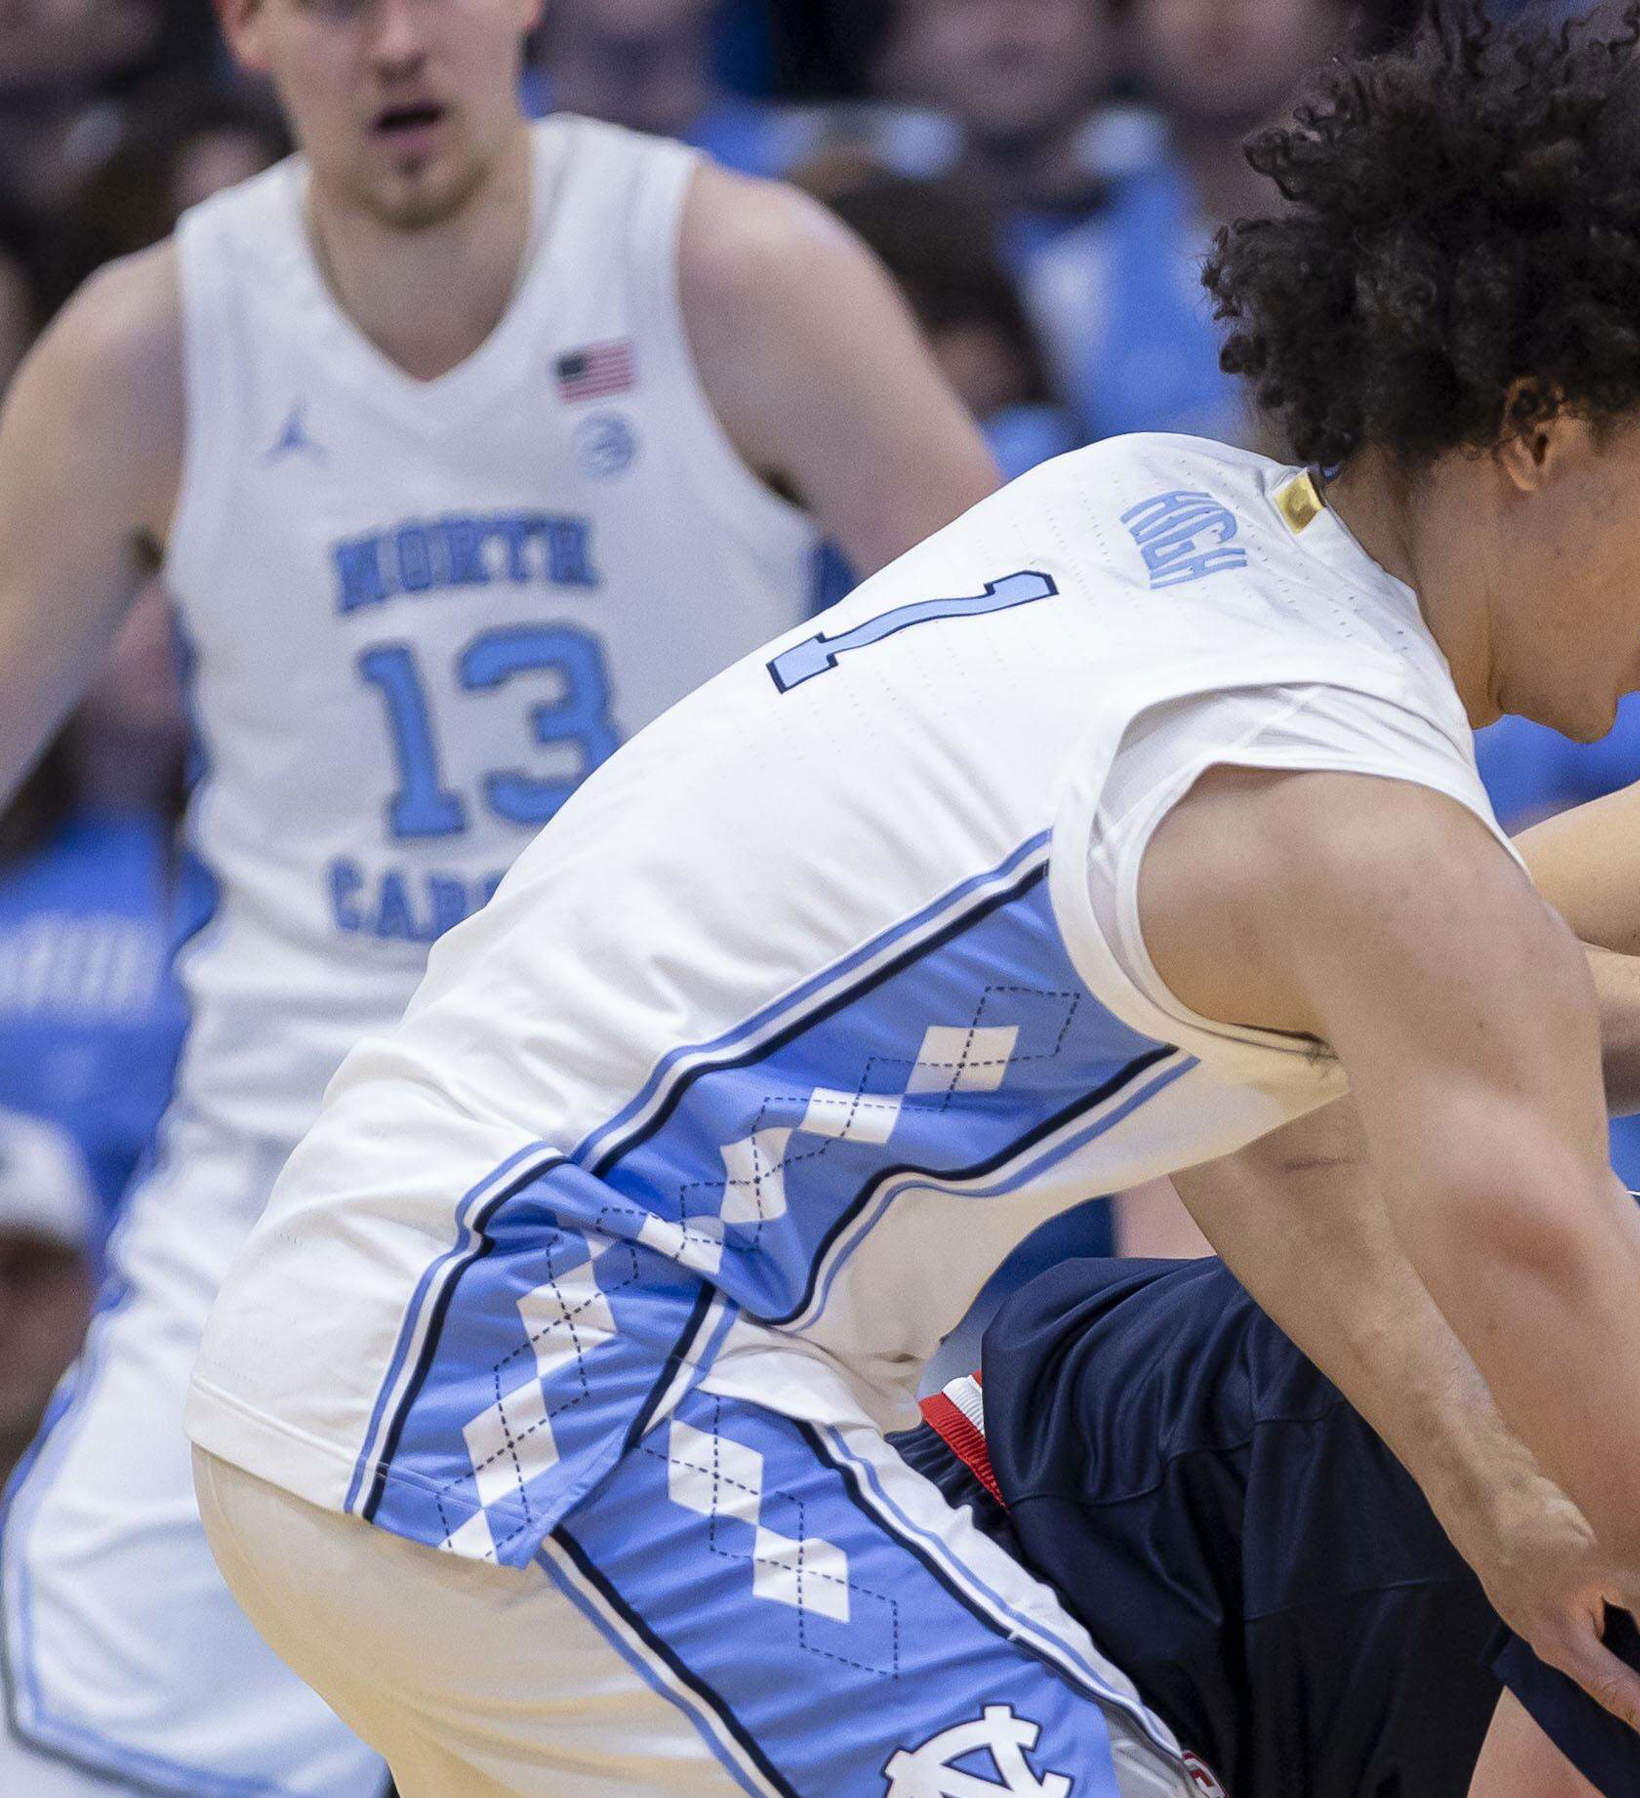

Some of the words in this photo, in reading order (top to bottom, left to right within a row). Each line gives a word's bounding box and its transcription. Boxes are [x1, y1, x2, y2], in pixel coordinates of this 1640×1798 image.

[334, 513, 600, 614] NORTH
[1120, 490, 1248, 590] HIGH
[766, 569, 1058, 694] 1
[356, 622, 622, 842] 13
